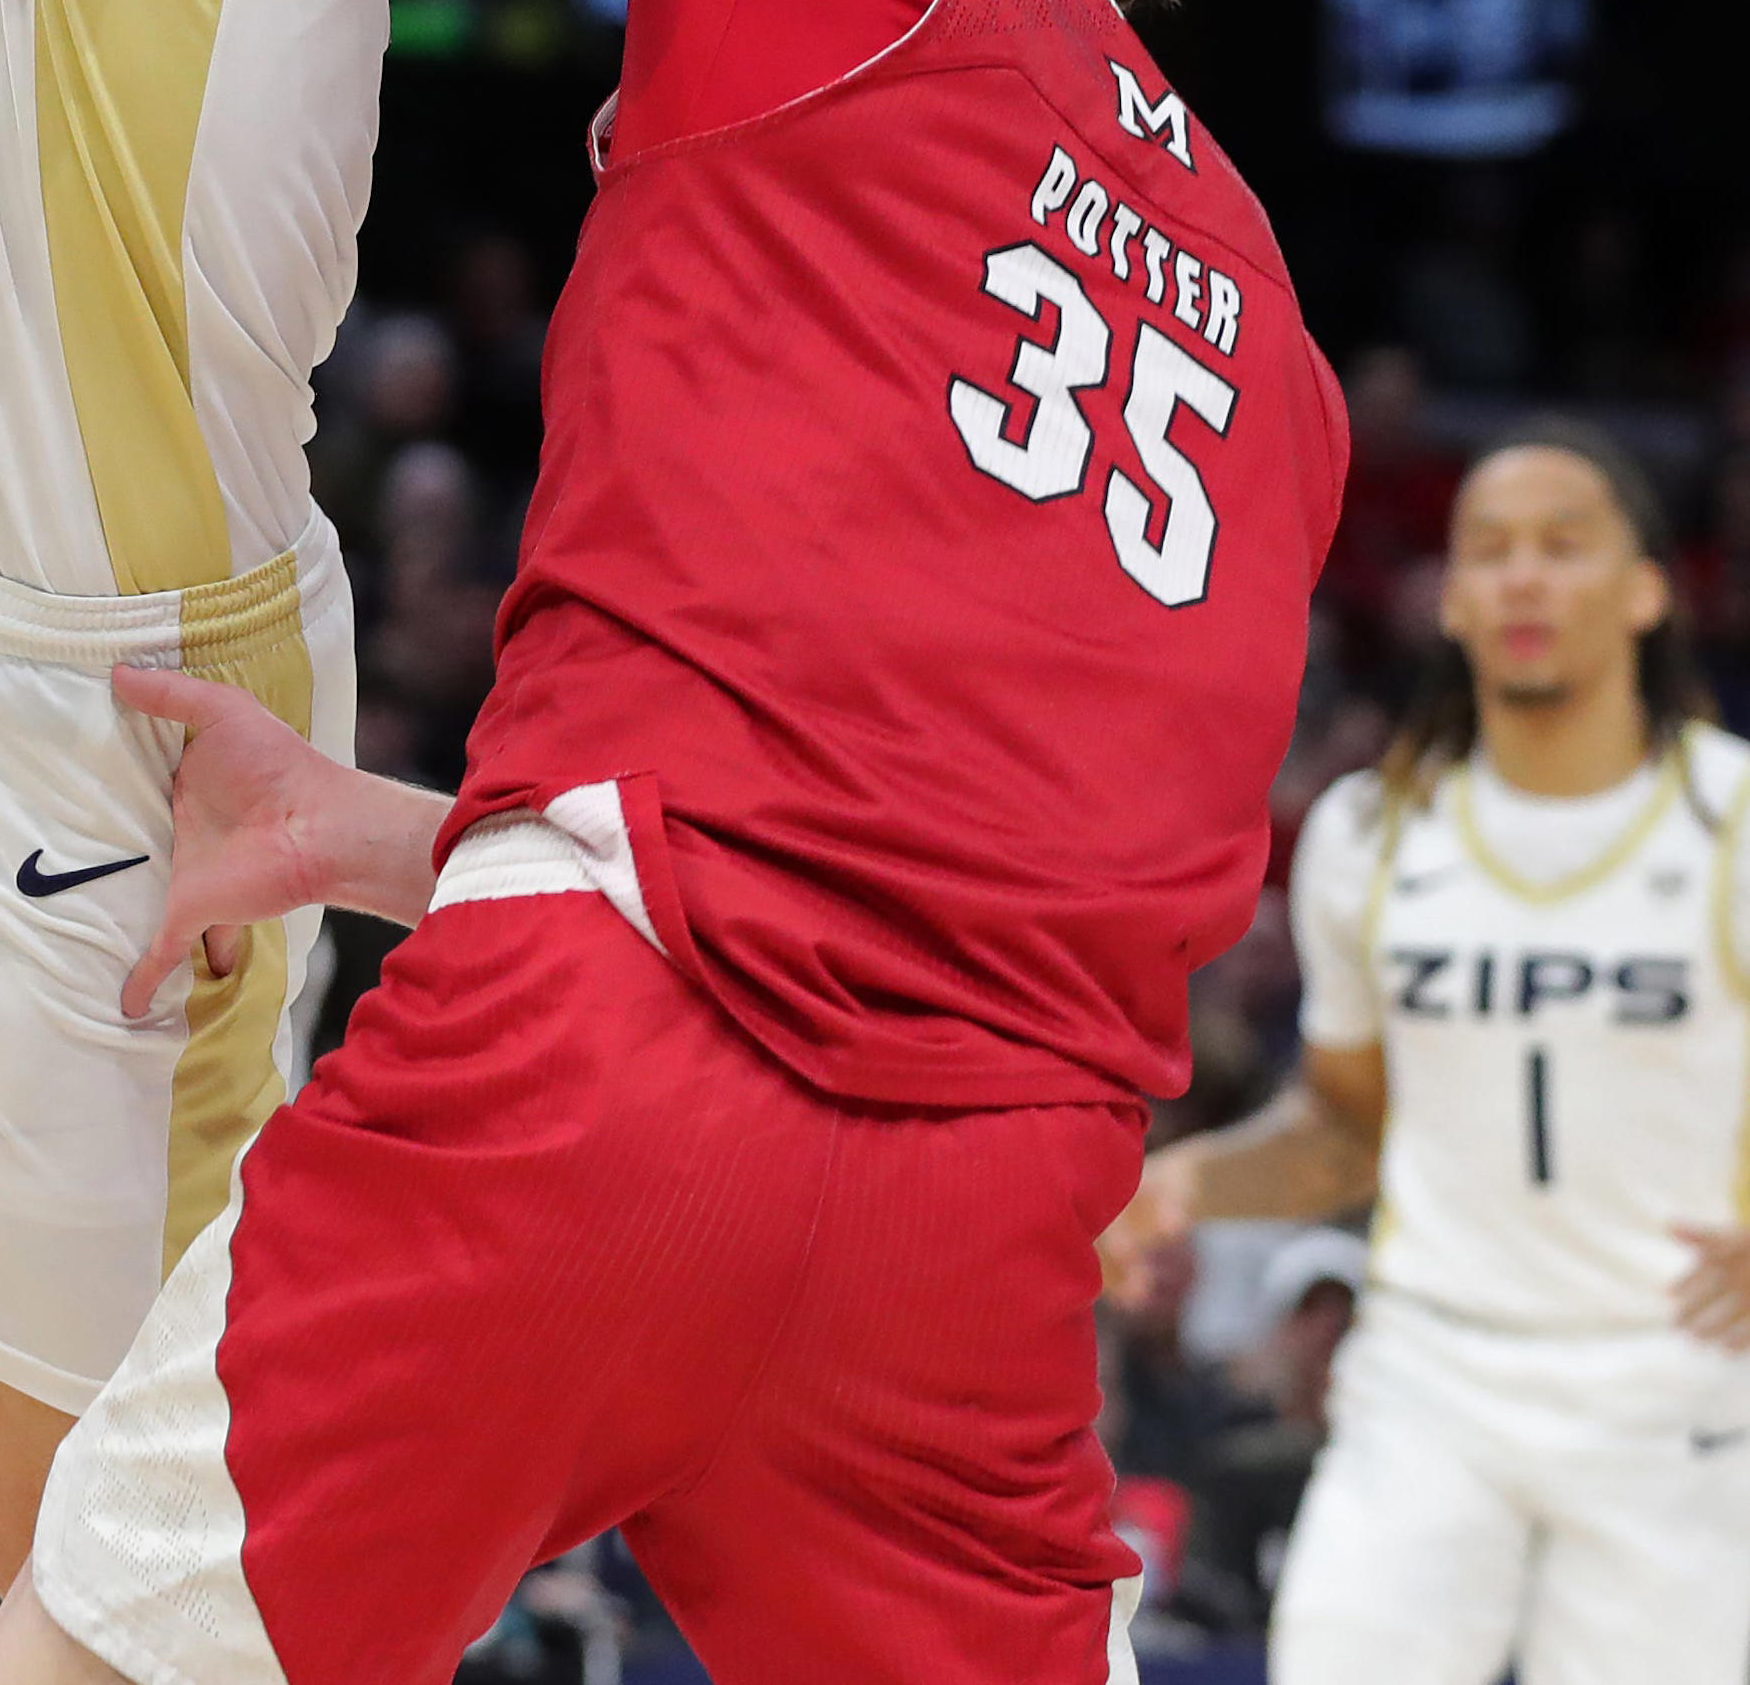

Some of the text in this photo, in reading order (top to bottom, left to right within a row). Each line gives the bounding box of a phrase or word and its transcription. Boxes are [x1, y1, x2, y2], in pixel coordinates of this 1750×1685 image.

[1102, 54, 1198, 174] M
[1029, 144, 1244, 357] POTTER
[946, 239, 1240, 609] 35
[1384, 945, 1692, 1025] ZIPS
[1523, 1043, 1553, 1188] 1
